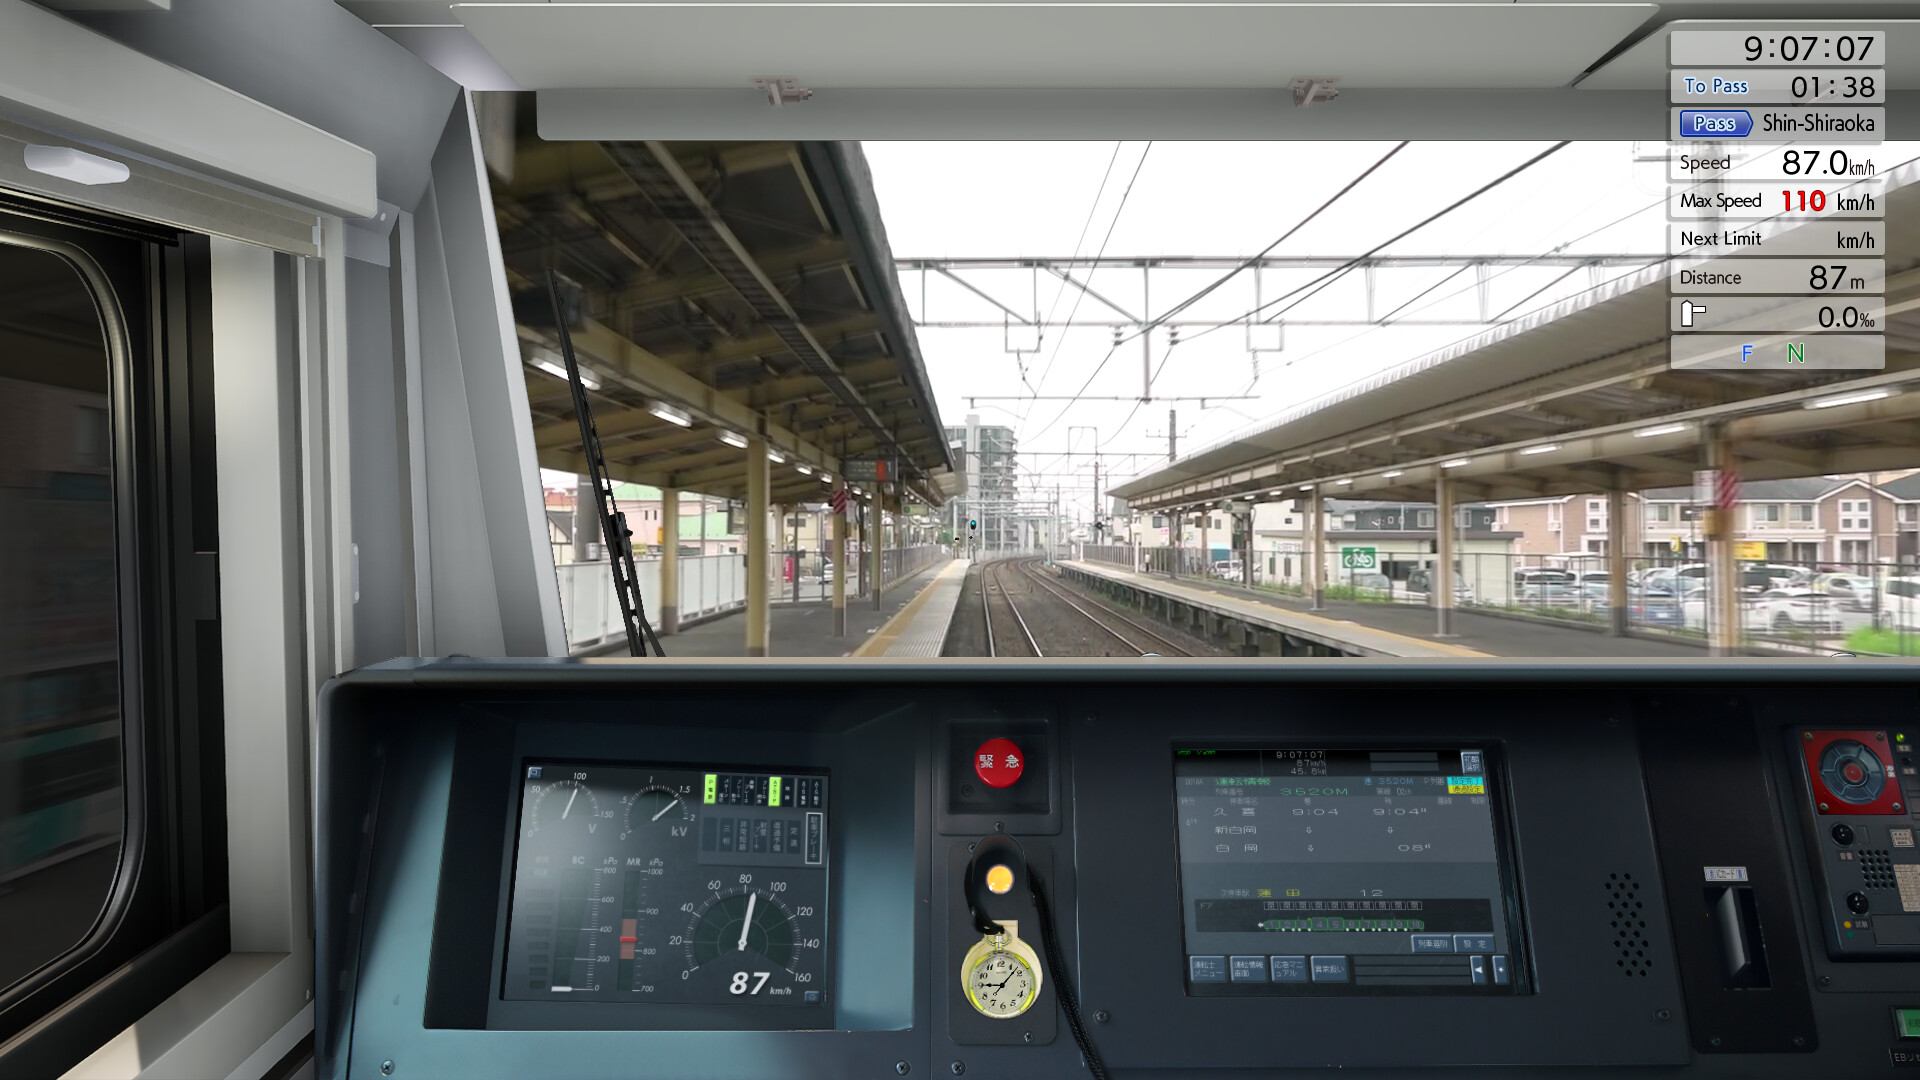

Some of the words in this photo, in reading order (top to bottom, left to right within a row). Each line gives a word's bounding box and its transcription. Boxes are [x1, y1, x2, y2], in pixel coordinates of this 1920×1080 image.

[979, 754, 1019, 769] 緊急
[572, 772, 586, 780] 100
[530, 786, 540, 794] 50
[679, 785, 690, 793] 1.5
[1280, 788, 1348, 796] 3520M
[600, 810, 614, 818] 150
[690, 814, 696, 822] 2
[588, 824, 597, 834] V
[671, 826, 688, 837] kV
[528, 830, 534, 838] 0
[620, 832, 626, 840] 0
[572, 856, 585, 865] BC
[603, 857, 618, 865] kPa
[627, 857, 641, 866] MR
[650, 858, 664, 867] kPa
[648, 868, 664, 876] 1000
[739, 874, 752, 884] 80
[708, 880, 721, 890] 60
[770, 882, 787, 892] 100
[602, 896, 614, 904] 600
[680, 903, 694, 912] 40
[796, 906, 813, 917] 120
[646, 908, 659, 916] 900
[600, 926, 612, 934] 400
[669, 936, 682, 946] 20
[802, 938, 820, 949] 140
[643, 947, 656, 956] 800
[597, 955, 610, 963] 200
[682, 970, 689, 980] 0
[794, 972, 812, 983] 160
[980, 972, 988, 980] 10
[729, 971, 770, 996] 87
[770, 986, 792, 996] km/h
[978, 982, 984, 990] 9
[1020, 980, 1026, 988] 3
[594, 984, 600, 992] 0
[1000, 1002, 1006, 1010] 6
